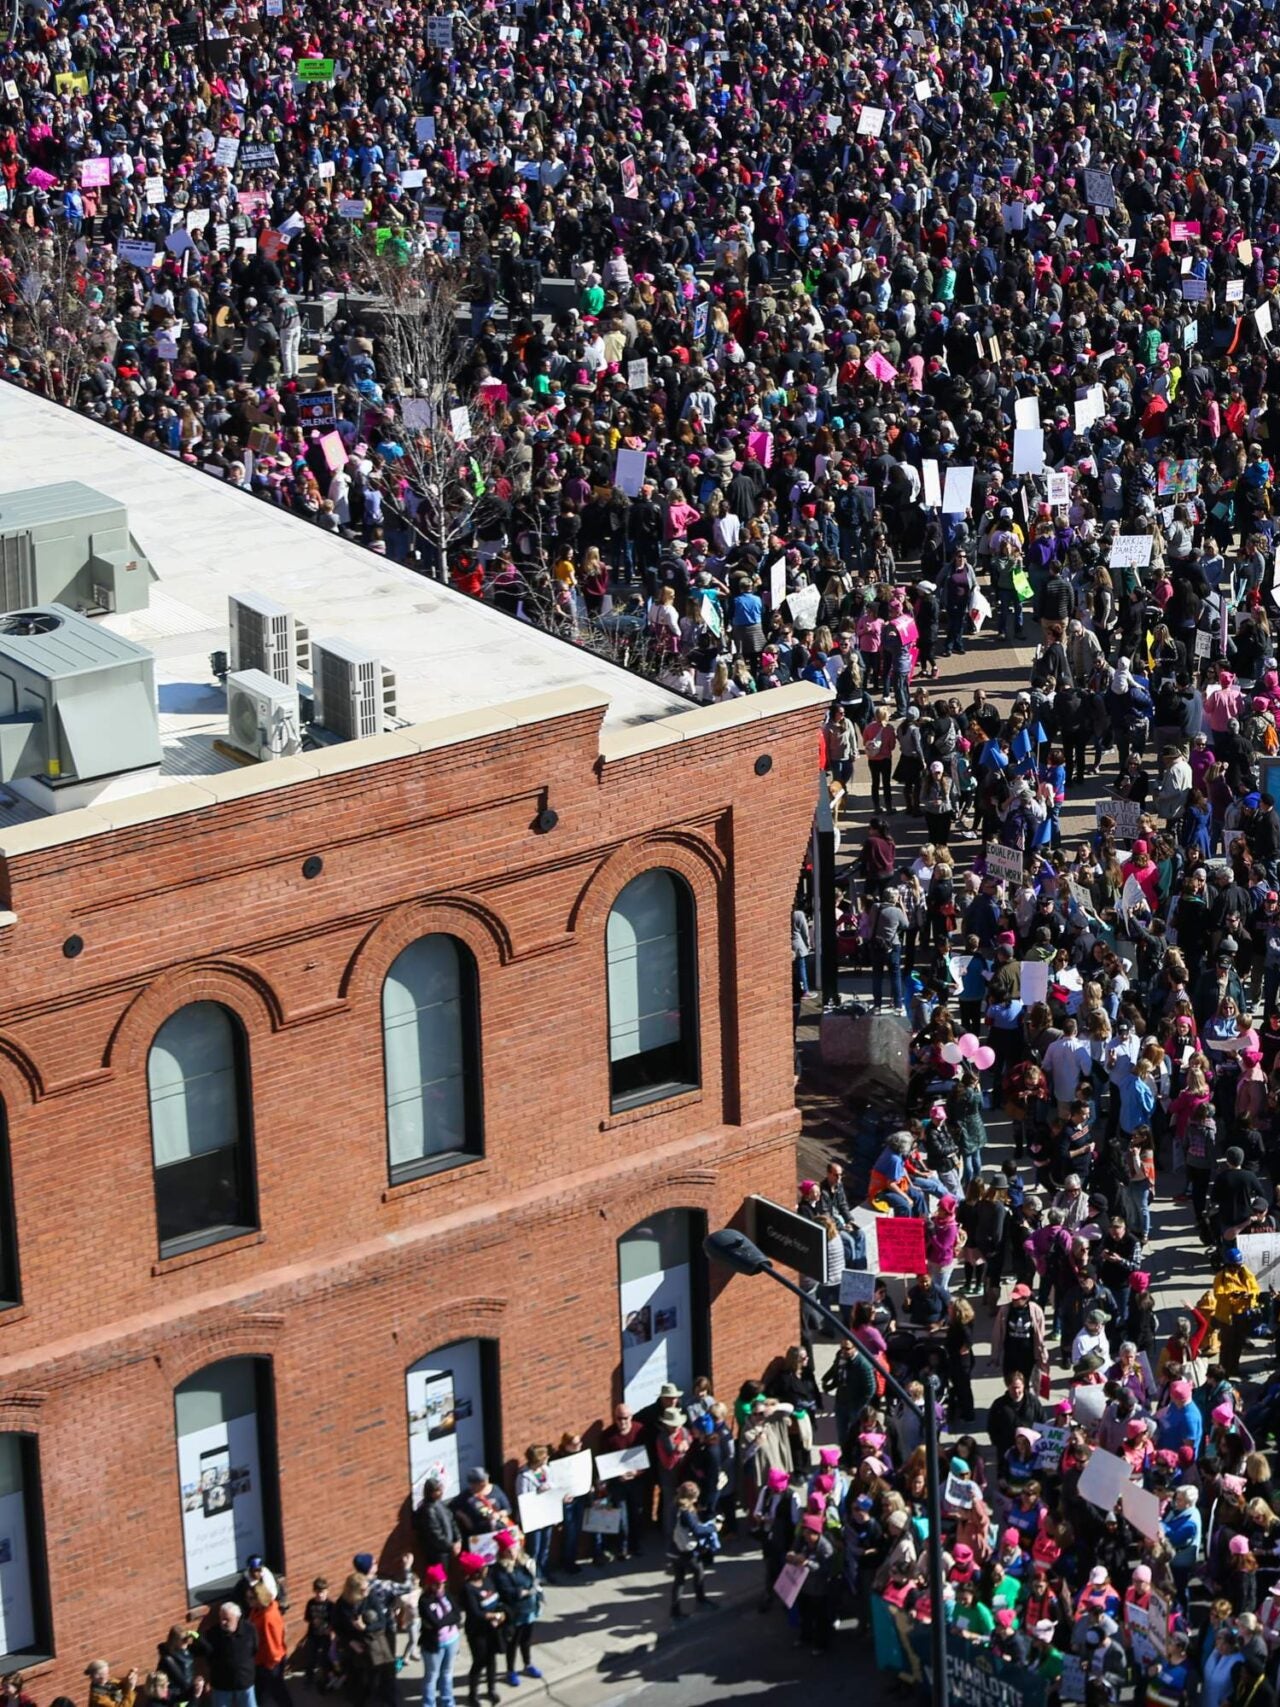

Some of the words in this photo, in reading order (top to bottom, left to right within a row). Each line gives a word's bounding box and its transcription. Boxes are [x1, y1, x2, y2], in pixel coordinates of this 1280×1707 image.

[298, 396, 334, 406] SCIENCE
[301, 416, 336, 427] SILENCE
[986, 843, 1006, 858] EQUAL
[1007, 849, 1020, 862] PAY
[944, 1653, 1024, 1707] CHARLOTTE
